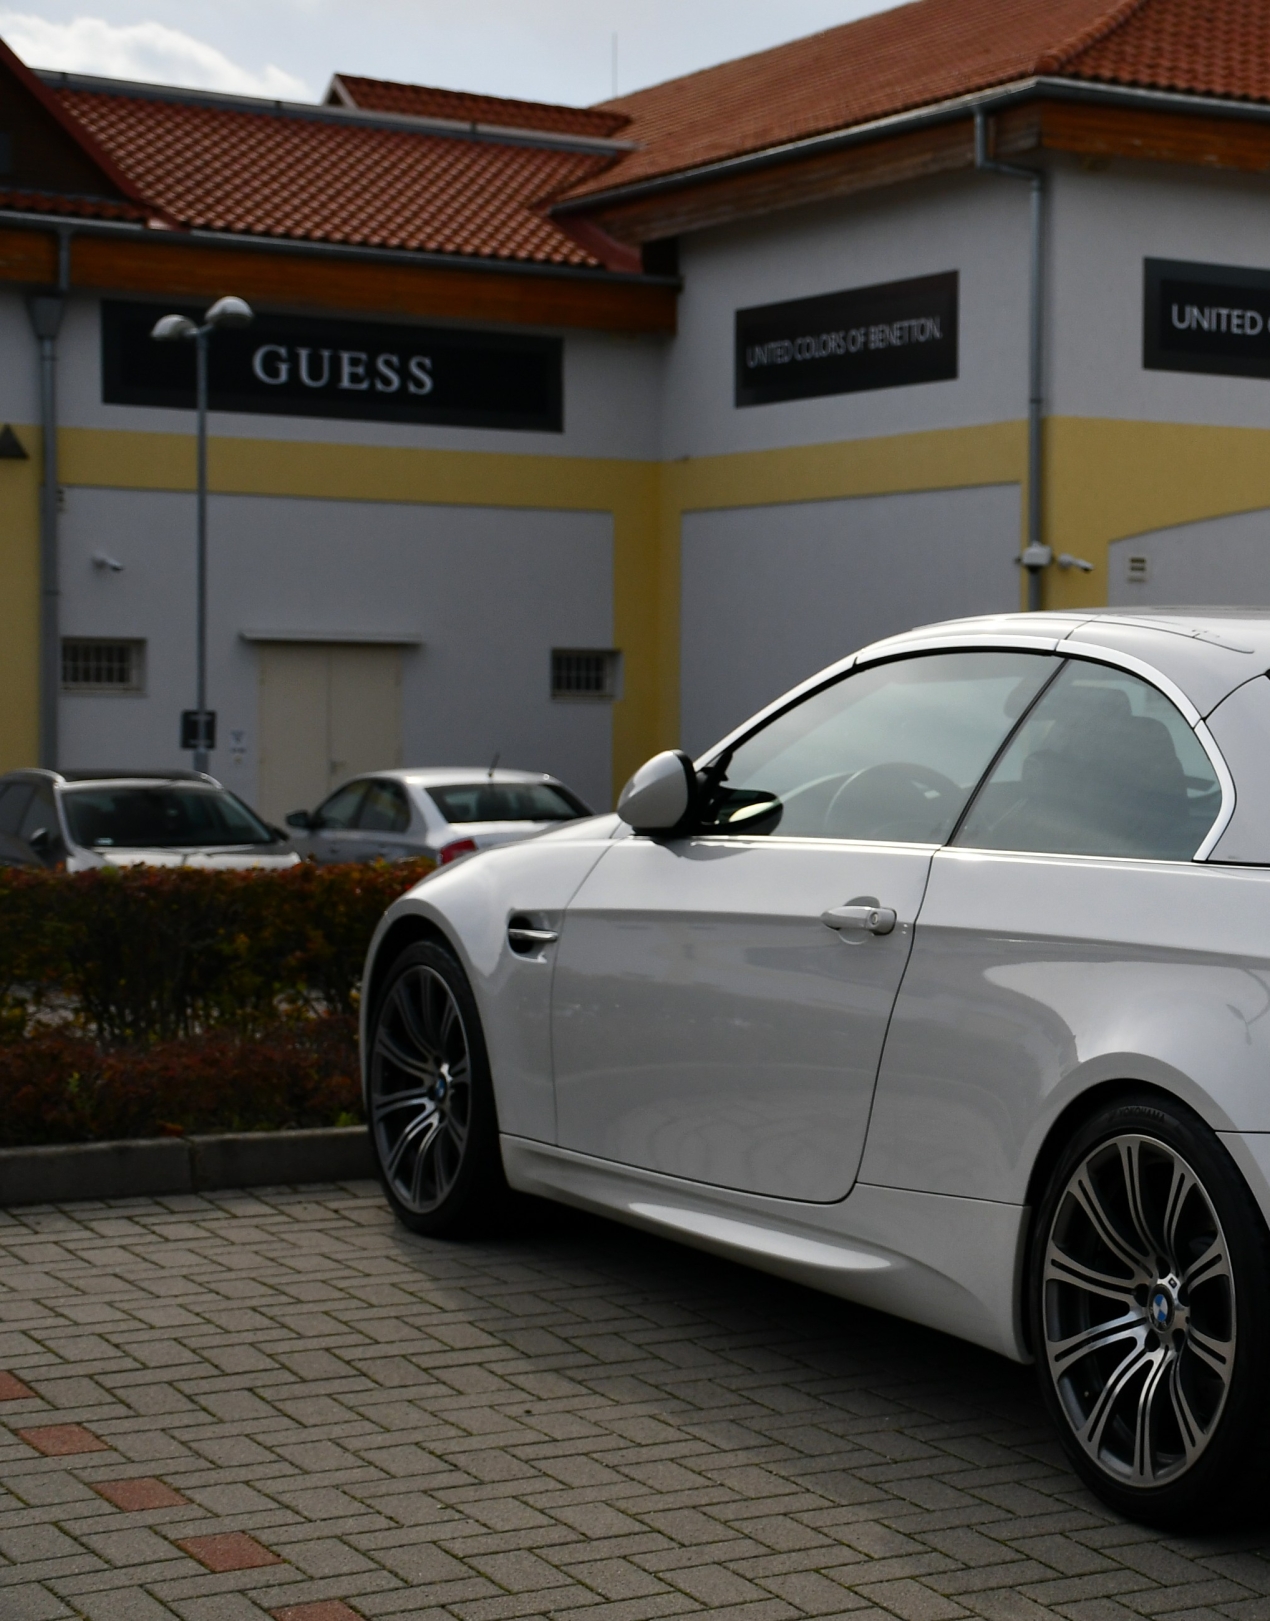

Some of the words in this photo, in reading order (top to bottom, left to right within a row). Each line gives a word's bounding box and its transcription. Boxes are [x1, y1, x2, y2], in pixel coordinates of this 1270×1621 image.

[1171, 303, 1263, 336] UNITED
[746, 339, 793, 368] UNITED
[793, 331, 845, 361] COLORS
[848, 327, 868, 352] OF
[252, 343, 434, 396] GUESS
